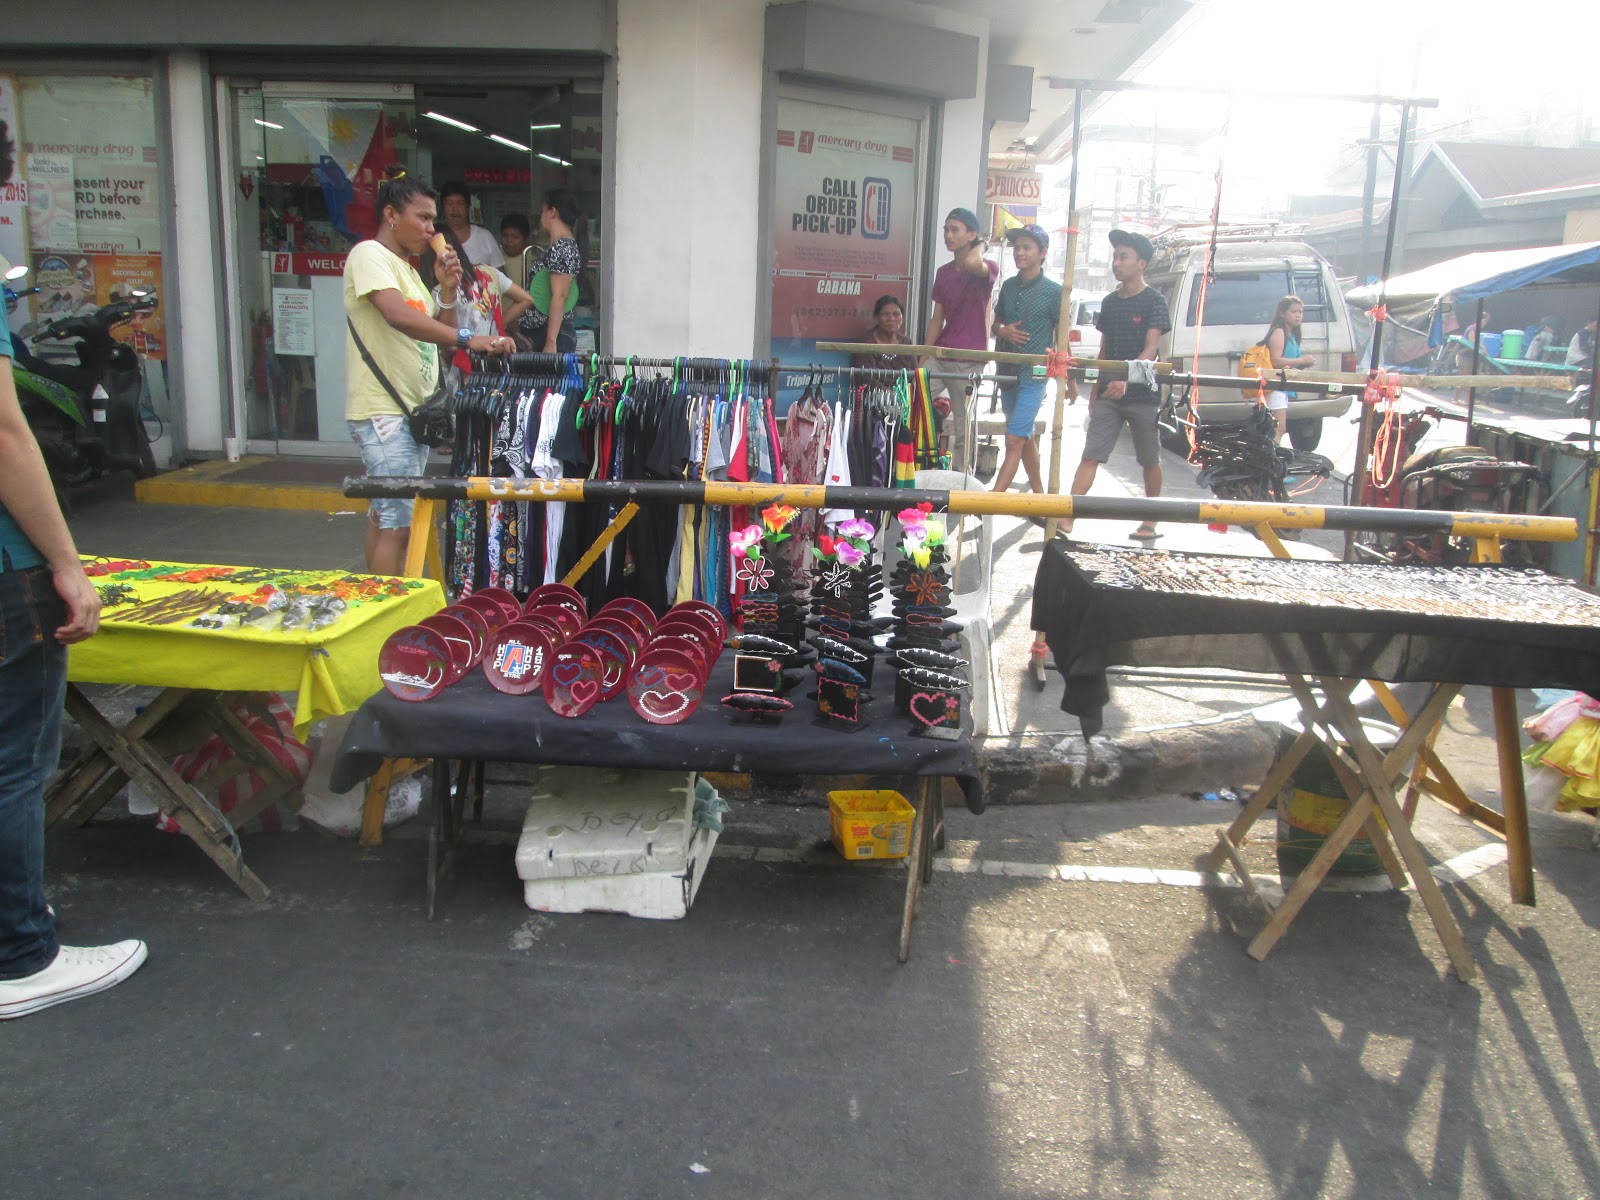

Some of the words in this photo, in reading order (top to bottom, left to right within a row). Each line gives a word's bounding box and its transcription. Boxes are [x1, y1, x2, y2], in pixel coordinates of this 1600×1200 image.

[38, 143, 99, 155] mercury
[103, 144, 134, 156] drug
[818, 134, 861, 151] mercury
[864, 140, 887, 154] drug
[74, 179, 110, 190] esent
[114, 179, 144, 191] your
[822, 177, 857, 198] CALL
[994, 175, 1041, 198] PRINCESS
[75, 192, 96, 204] RD
[100, 191, 141, 205] before
[806, 195, 857, 217] ORDER
[76, 208, 126, 220] rchase.
[792, 213, 857, 236] PICK-UP
[817, 280, 861, 295] CABANA
[786, 375, 811, 387] Triple
